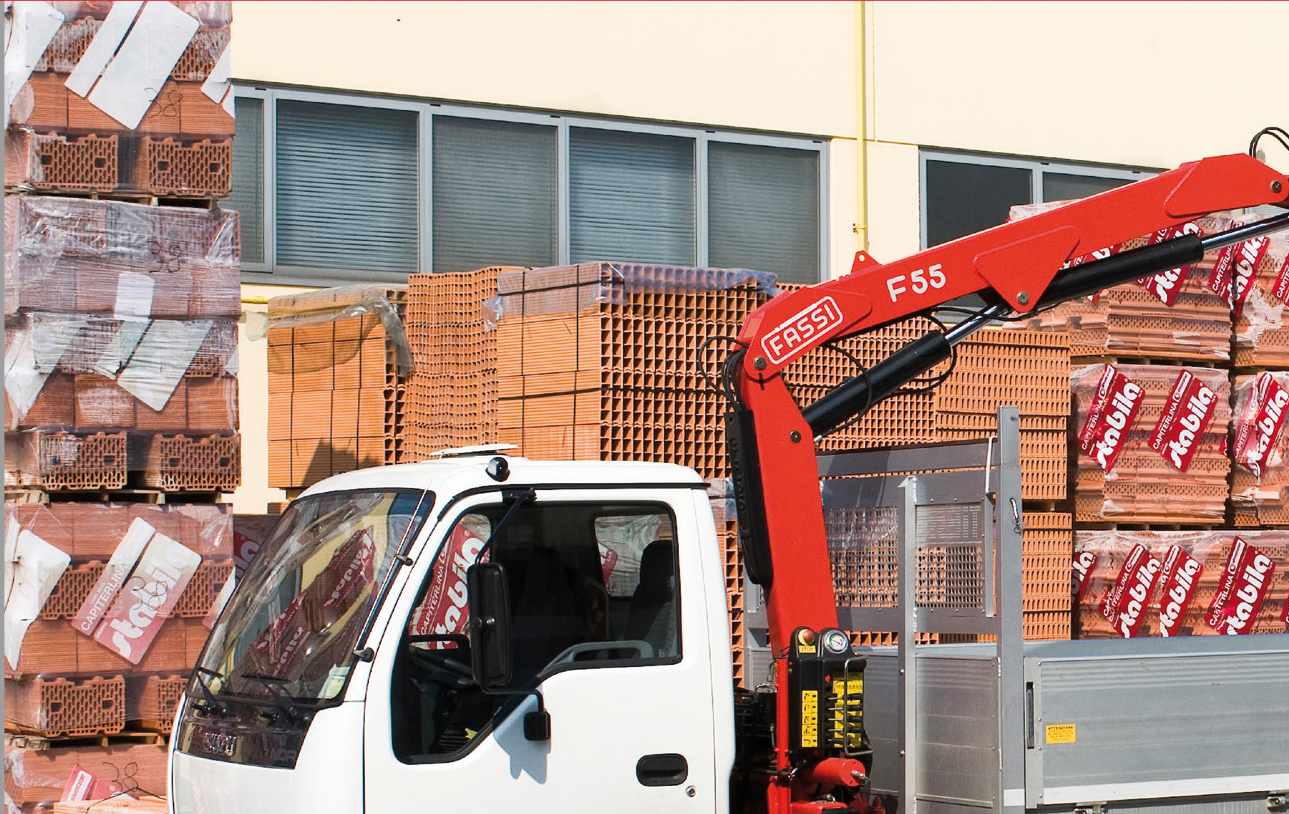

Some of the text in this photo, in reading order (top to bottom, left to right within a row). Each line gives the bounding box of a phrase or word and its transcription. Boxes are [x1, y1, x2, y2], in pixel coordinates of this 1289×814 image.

[886, 263, 947, 303] F 55
[768, 303, 836, 357] FASSI
[1096, 382, 1142, 469] stabila
[1152, 402, 1179, 450] CAPITERLINA
[1168, 386, 1214, 469] stabila
[110, 544, 191, 659] stabila
[421, 565, 444, 635] CAPITERLINA
[1119, 558, 1162, 638] stabila
[1226, 554, 1272, 635] stabila
